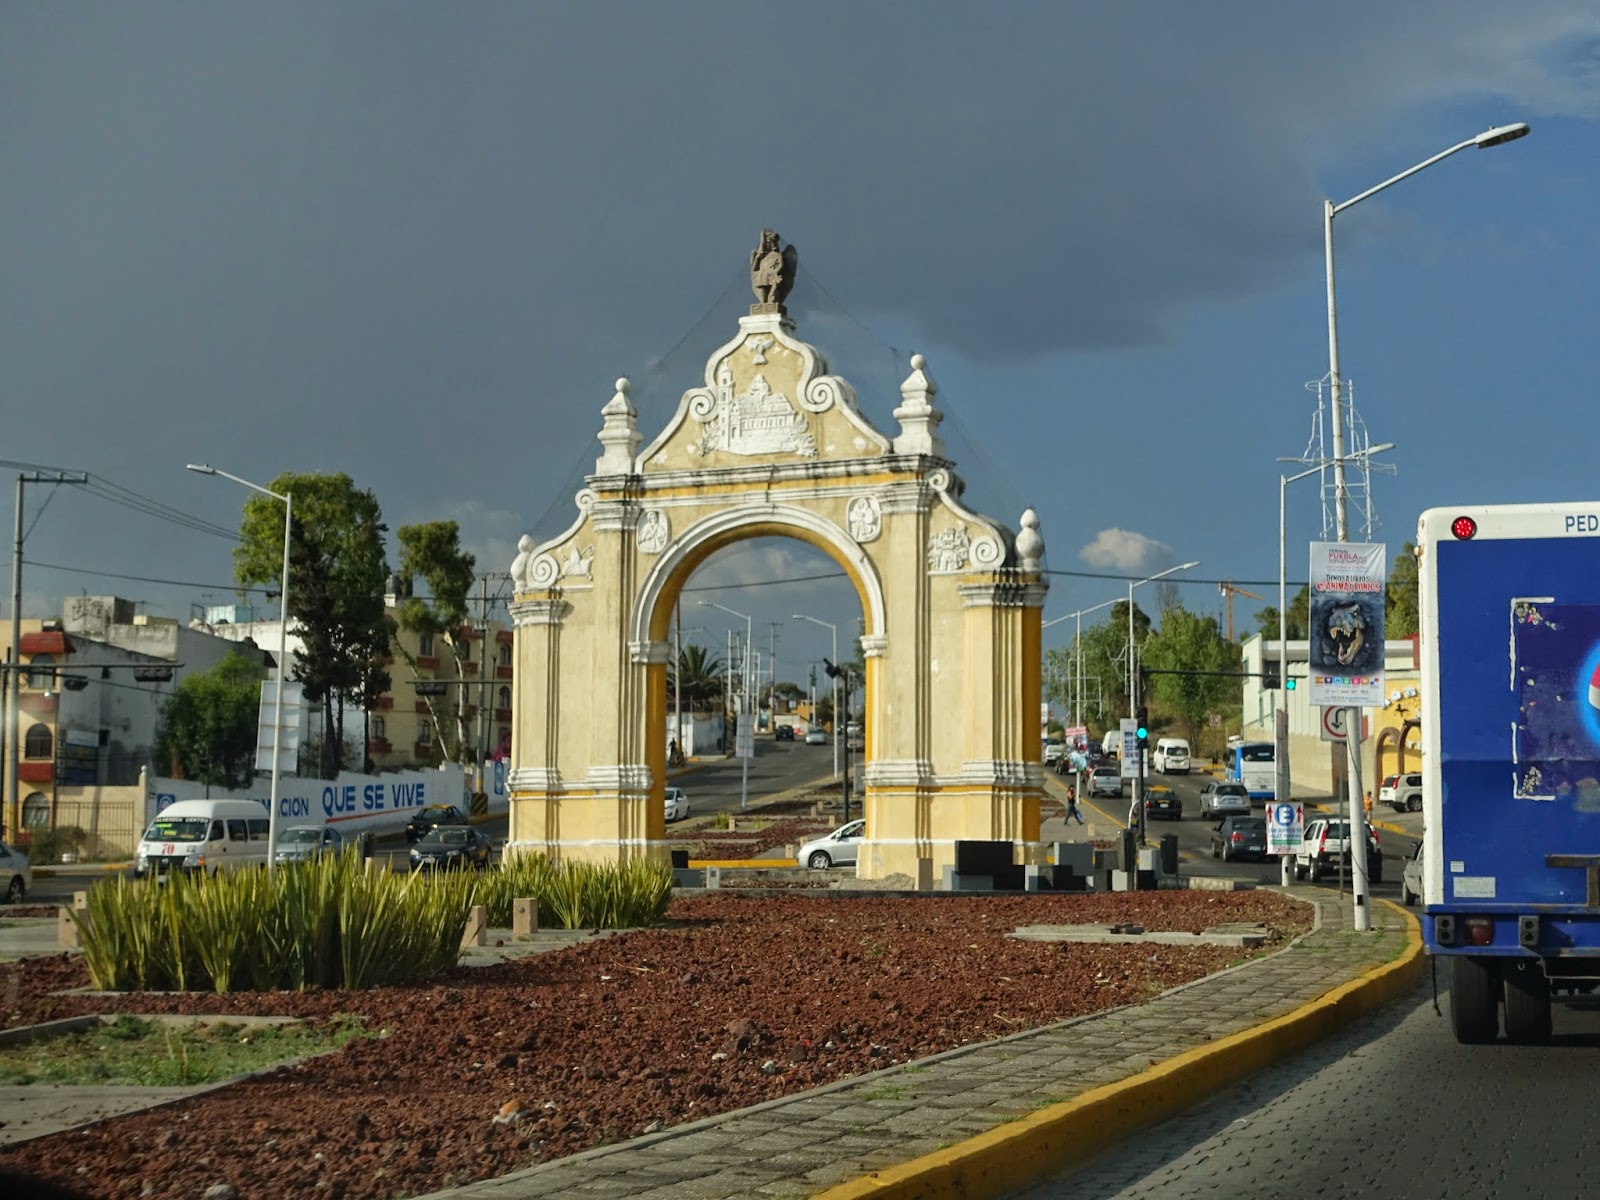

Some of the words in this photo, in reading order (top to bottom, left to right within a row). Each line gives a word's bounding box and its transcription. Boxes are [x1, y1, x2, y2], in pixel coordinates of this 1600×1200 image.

[1328, 552, 1359, 560] PUEBLA
[322, 785, 356, 817] QUE
[363, 784, 384, 810] SE
[392, 783, 425, 808] VIVE
[1278, 807, 1291, 824] E
[161, 844, 174, 855] 70
